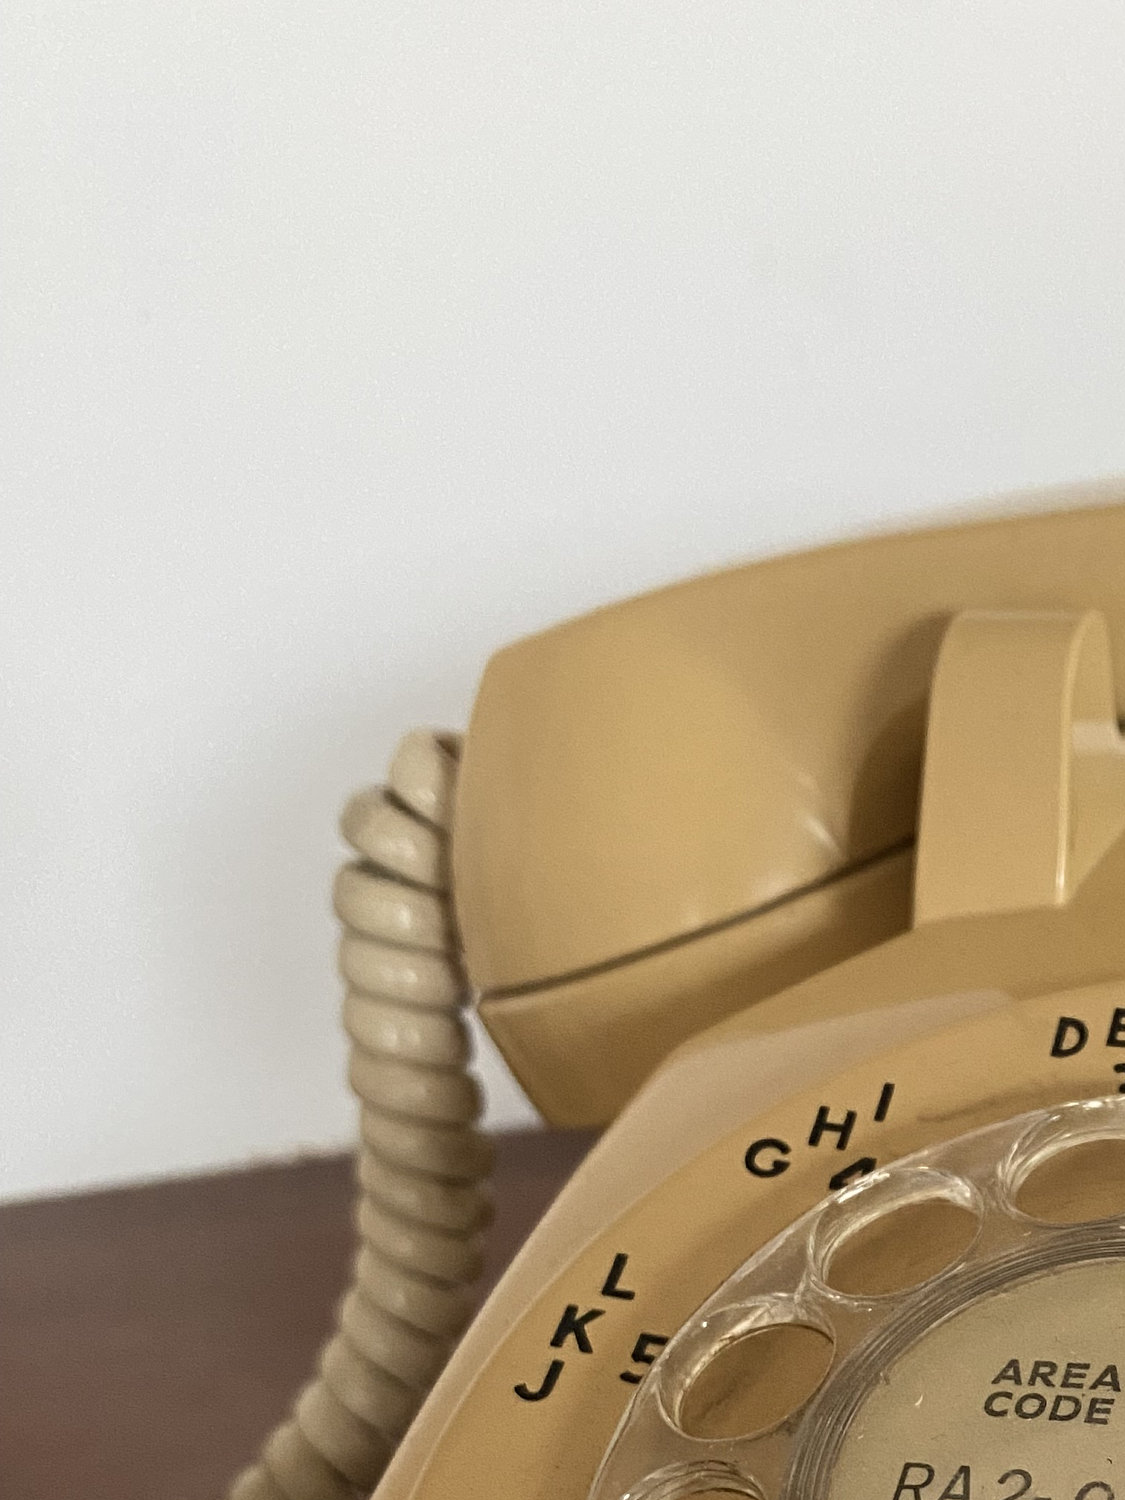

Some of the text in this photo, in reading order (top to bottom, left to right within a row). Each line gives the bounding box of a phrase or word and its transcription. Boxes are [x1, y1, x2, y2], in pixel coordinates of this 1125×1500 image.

[744, 1082, 896, 1179] GHI
[619, 1332, 671, 1385] 5
[991, 1358, 1122, 1393] AREA
[983, 1391, 1116, 1426] CODE
